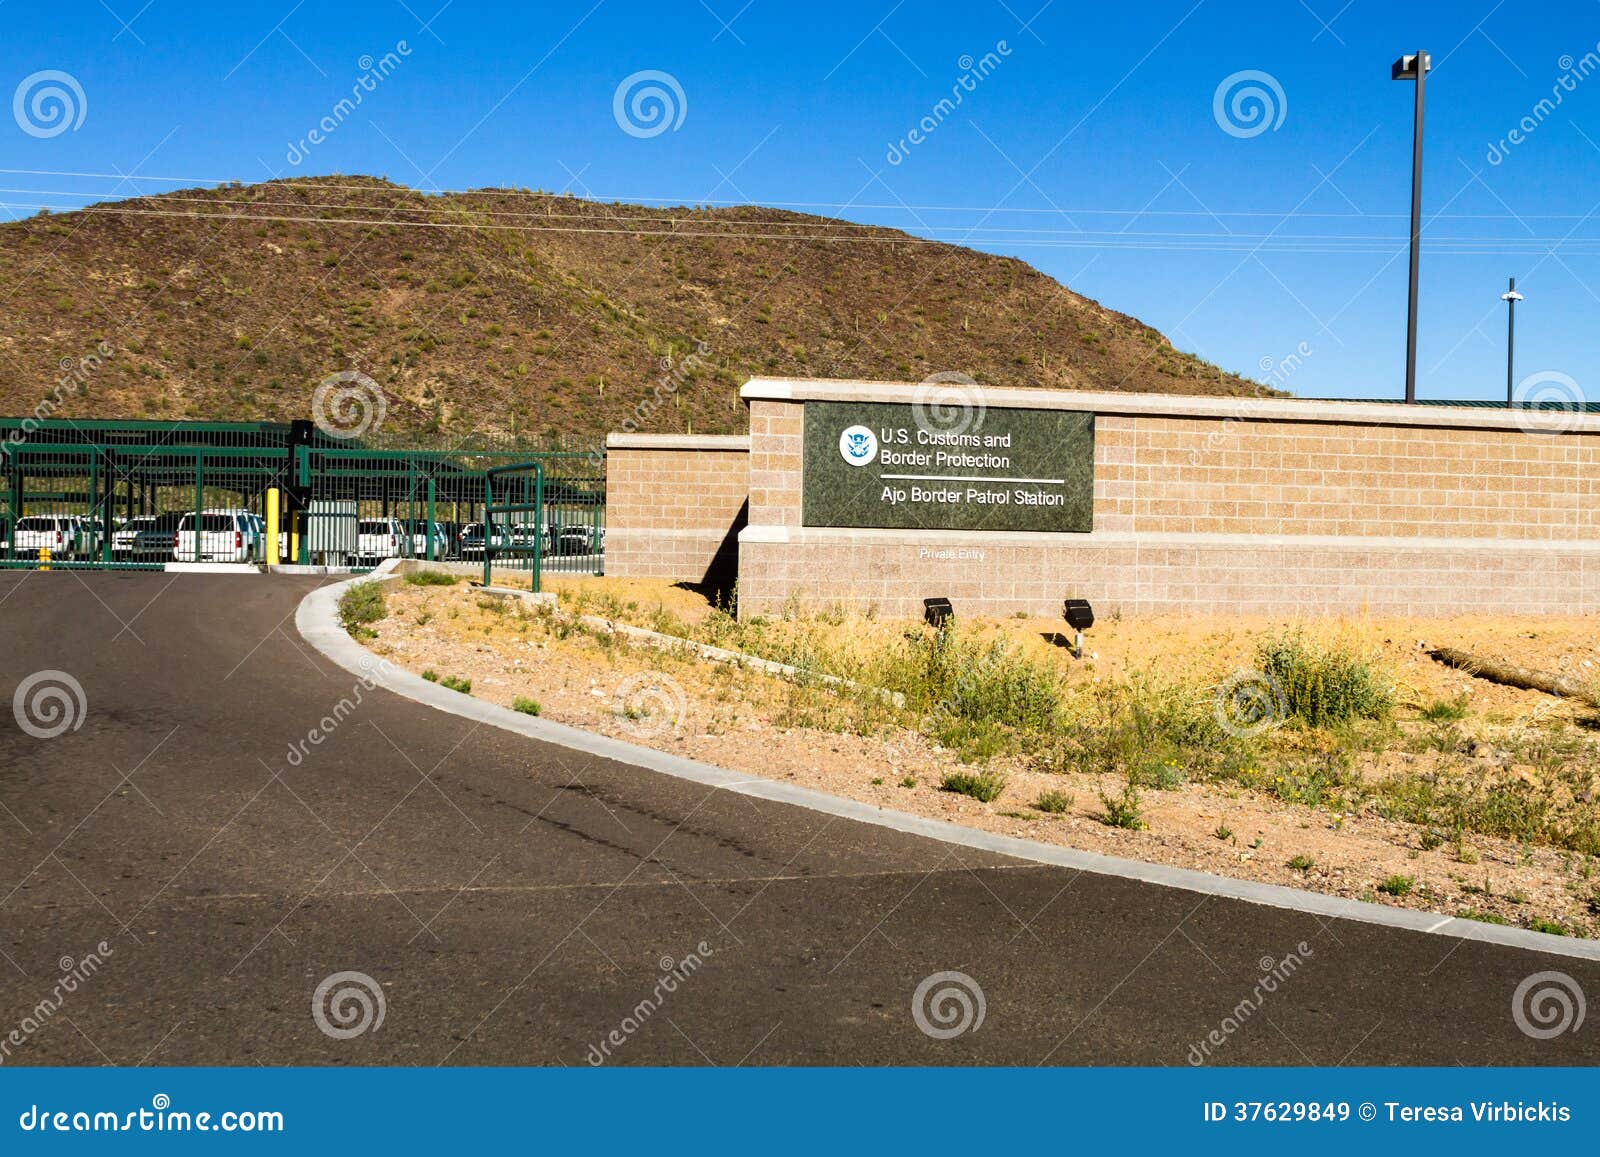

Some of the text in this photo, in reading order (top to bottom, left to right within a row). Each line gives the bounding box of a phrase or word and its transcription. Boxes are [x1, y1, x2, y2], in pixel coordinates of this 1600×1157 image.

[880, 428, 1011, 448] U.S. Customs and
[880, 451, 1010, 469] Border Protection
[881, 487, 1064, 506] Ajo Border Patrol Station
[919, 548, 985, 562] Private Entry
